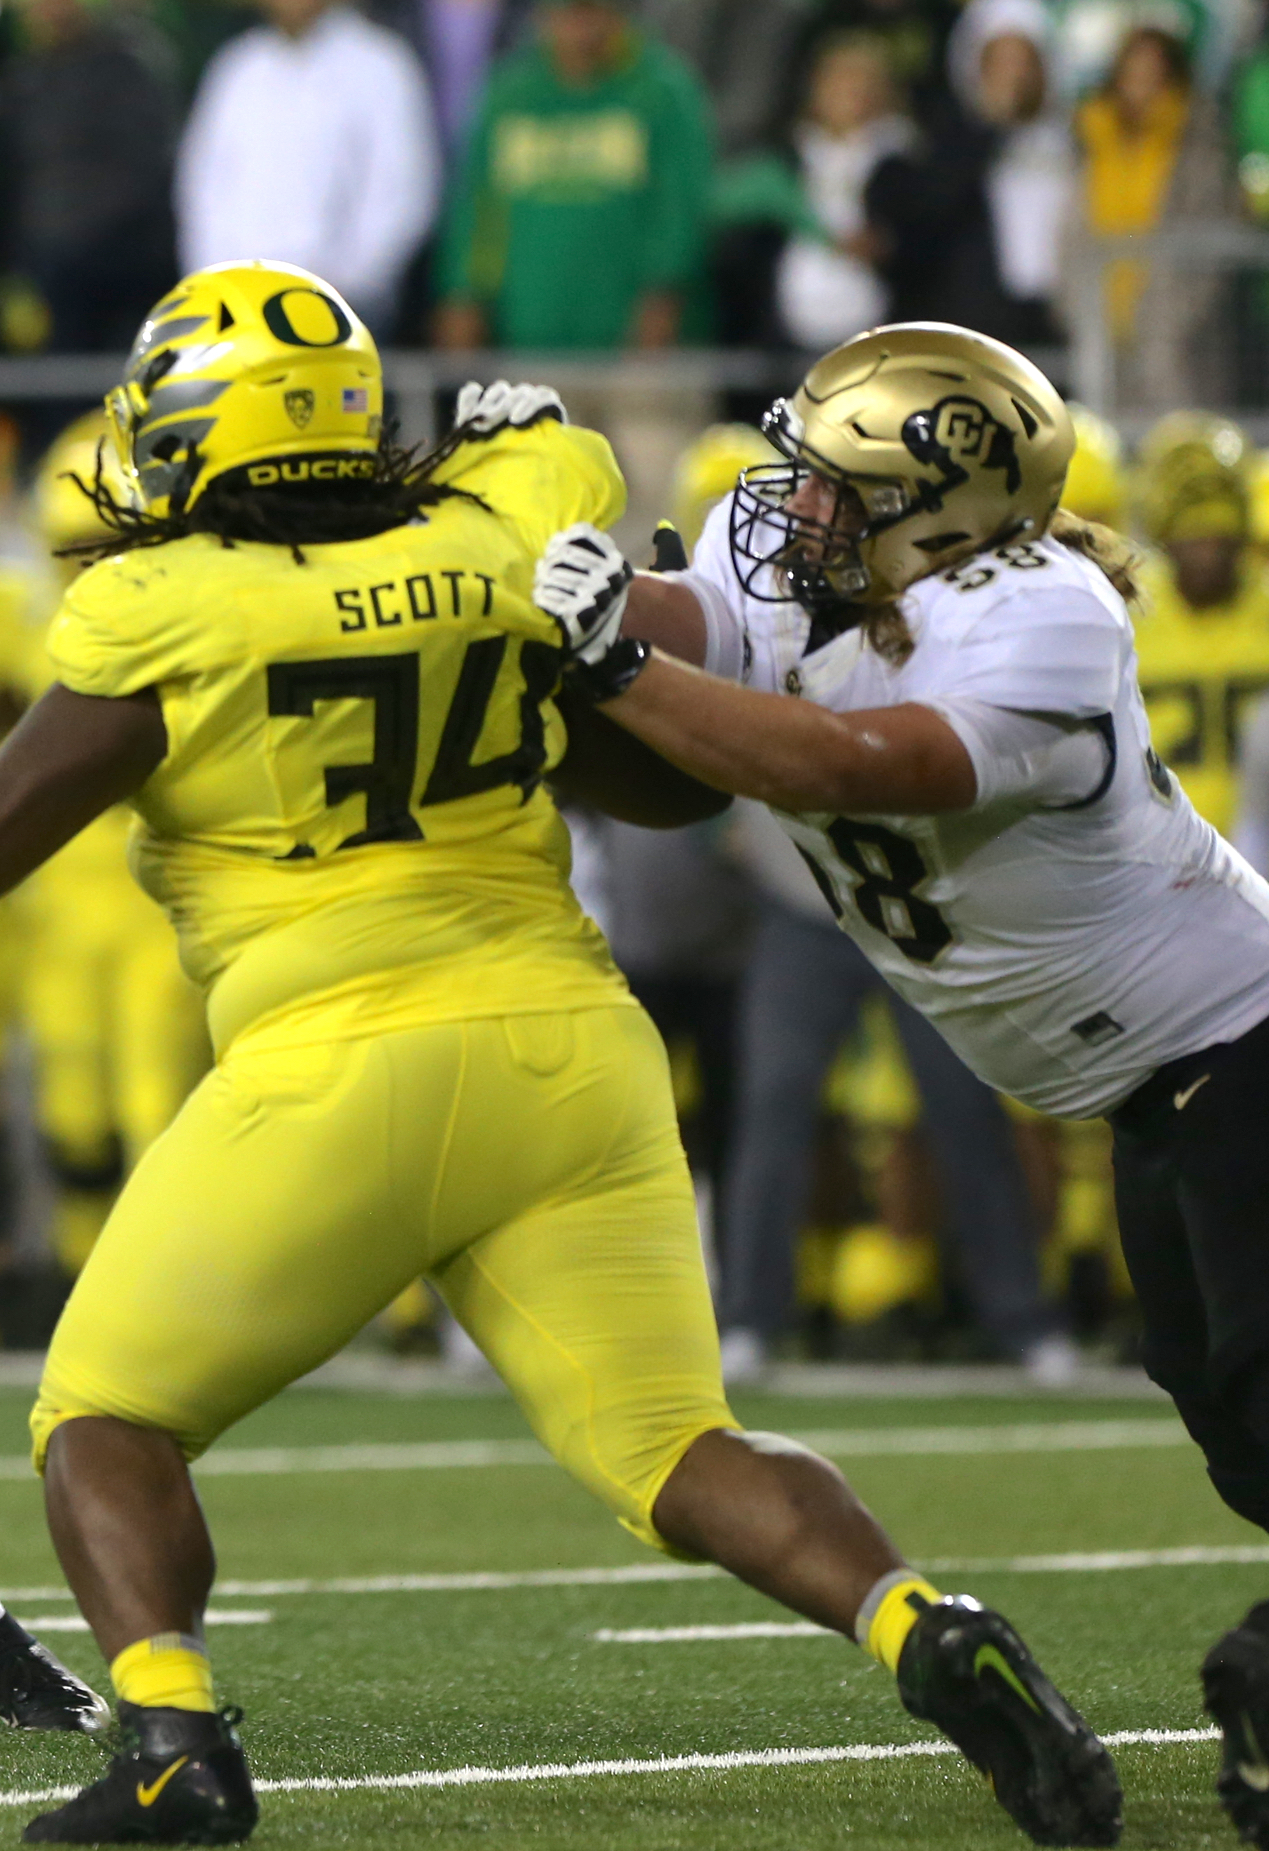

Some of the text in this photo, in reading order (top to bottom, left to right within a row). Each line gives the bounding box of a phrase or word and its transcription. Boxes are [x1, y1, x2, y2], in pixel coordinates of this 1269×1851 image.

[262, 288, 352, 347] O
[935, 403, 997, 470] CU
[247, 459, 375, 487] DUCKS
[333, 570, 498, 634] SCOTT
[267, 634, 548, 861] 34
